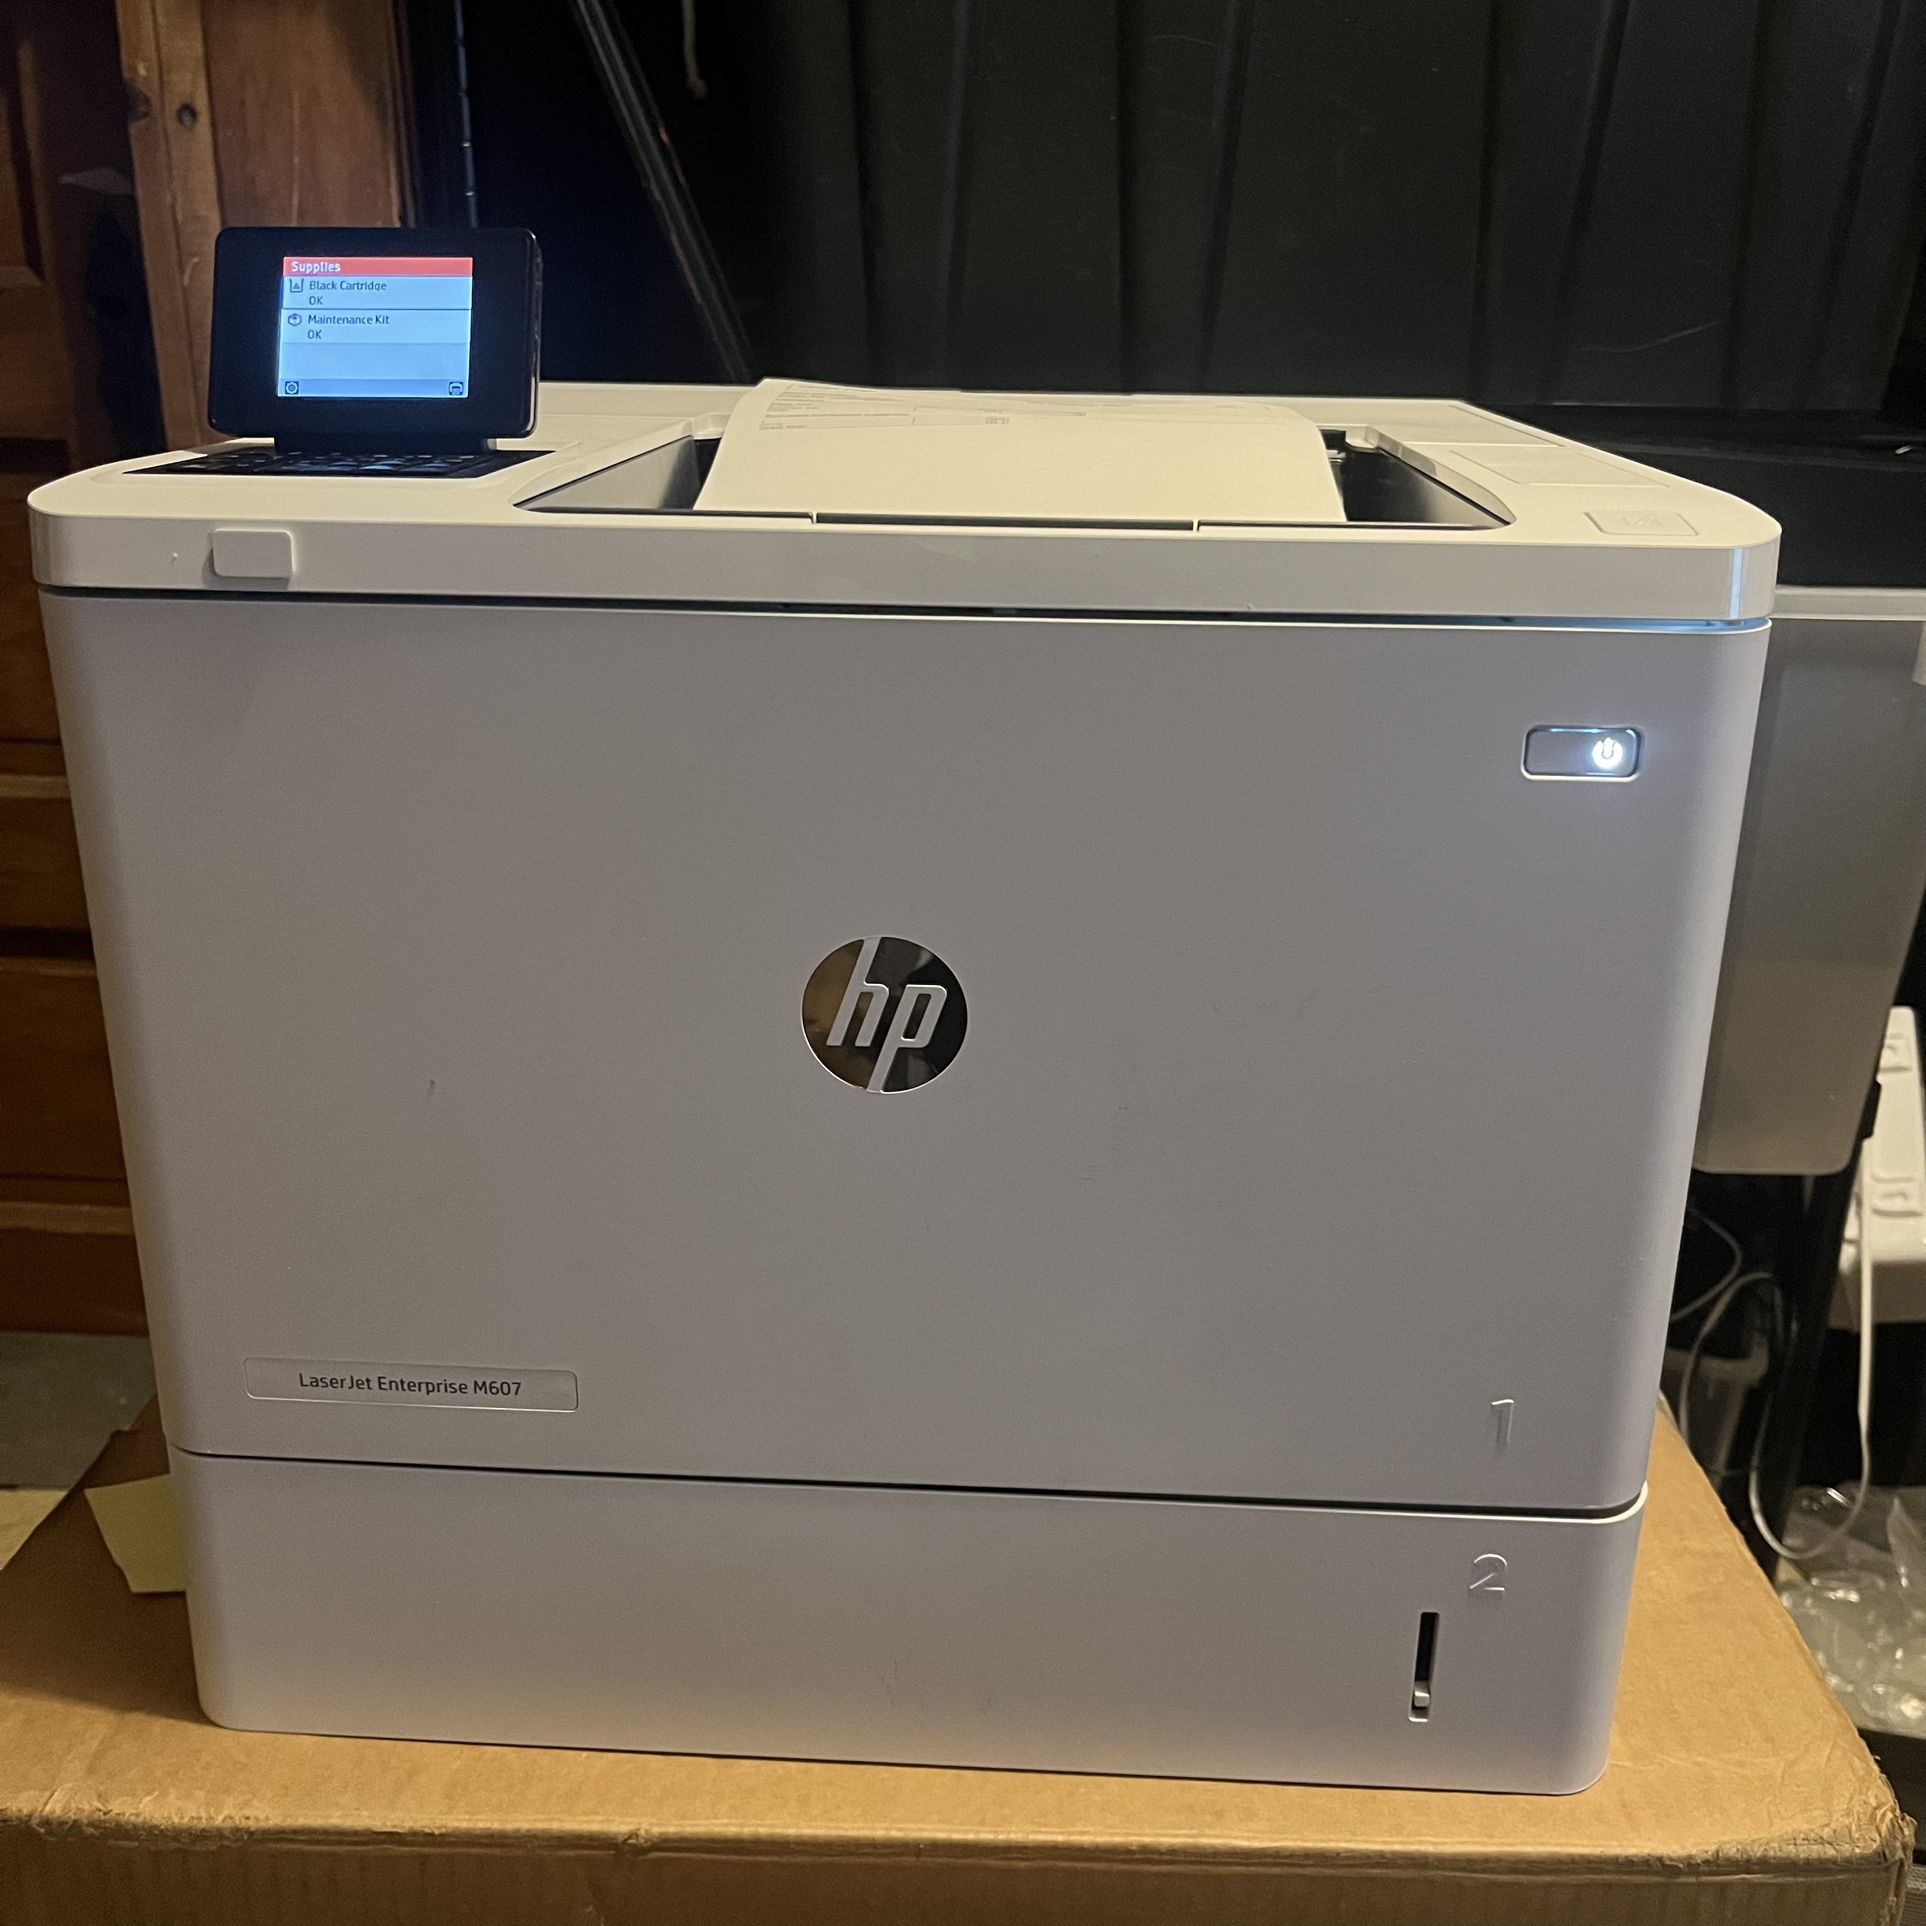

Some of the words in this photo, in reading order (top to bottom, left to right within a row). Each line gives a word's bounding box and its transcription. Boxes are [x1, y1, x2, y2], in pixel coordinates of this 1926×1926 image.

[291, 261, 341, 273] Supplies
[309, 280, 337, 291] Black
[340, 280, 387, 292] Cartridge
[309, 296, 323, 306] OK
[307, 314, 373, 325] Maintenance
[375, 314, 389, 325] Kit
[307, 329, 322, 340] OK
[826, 936, 948, 1093] hp
[299, 1373, 372, 1391] LaserJet
[377, 1376, 468, 1396] Enterprise
[473, 1380, 522, 1396] M607
[1491, 1398, 1515, 1446] 1
[1469, 1553, 1508, 1595] 2
